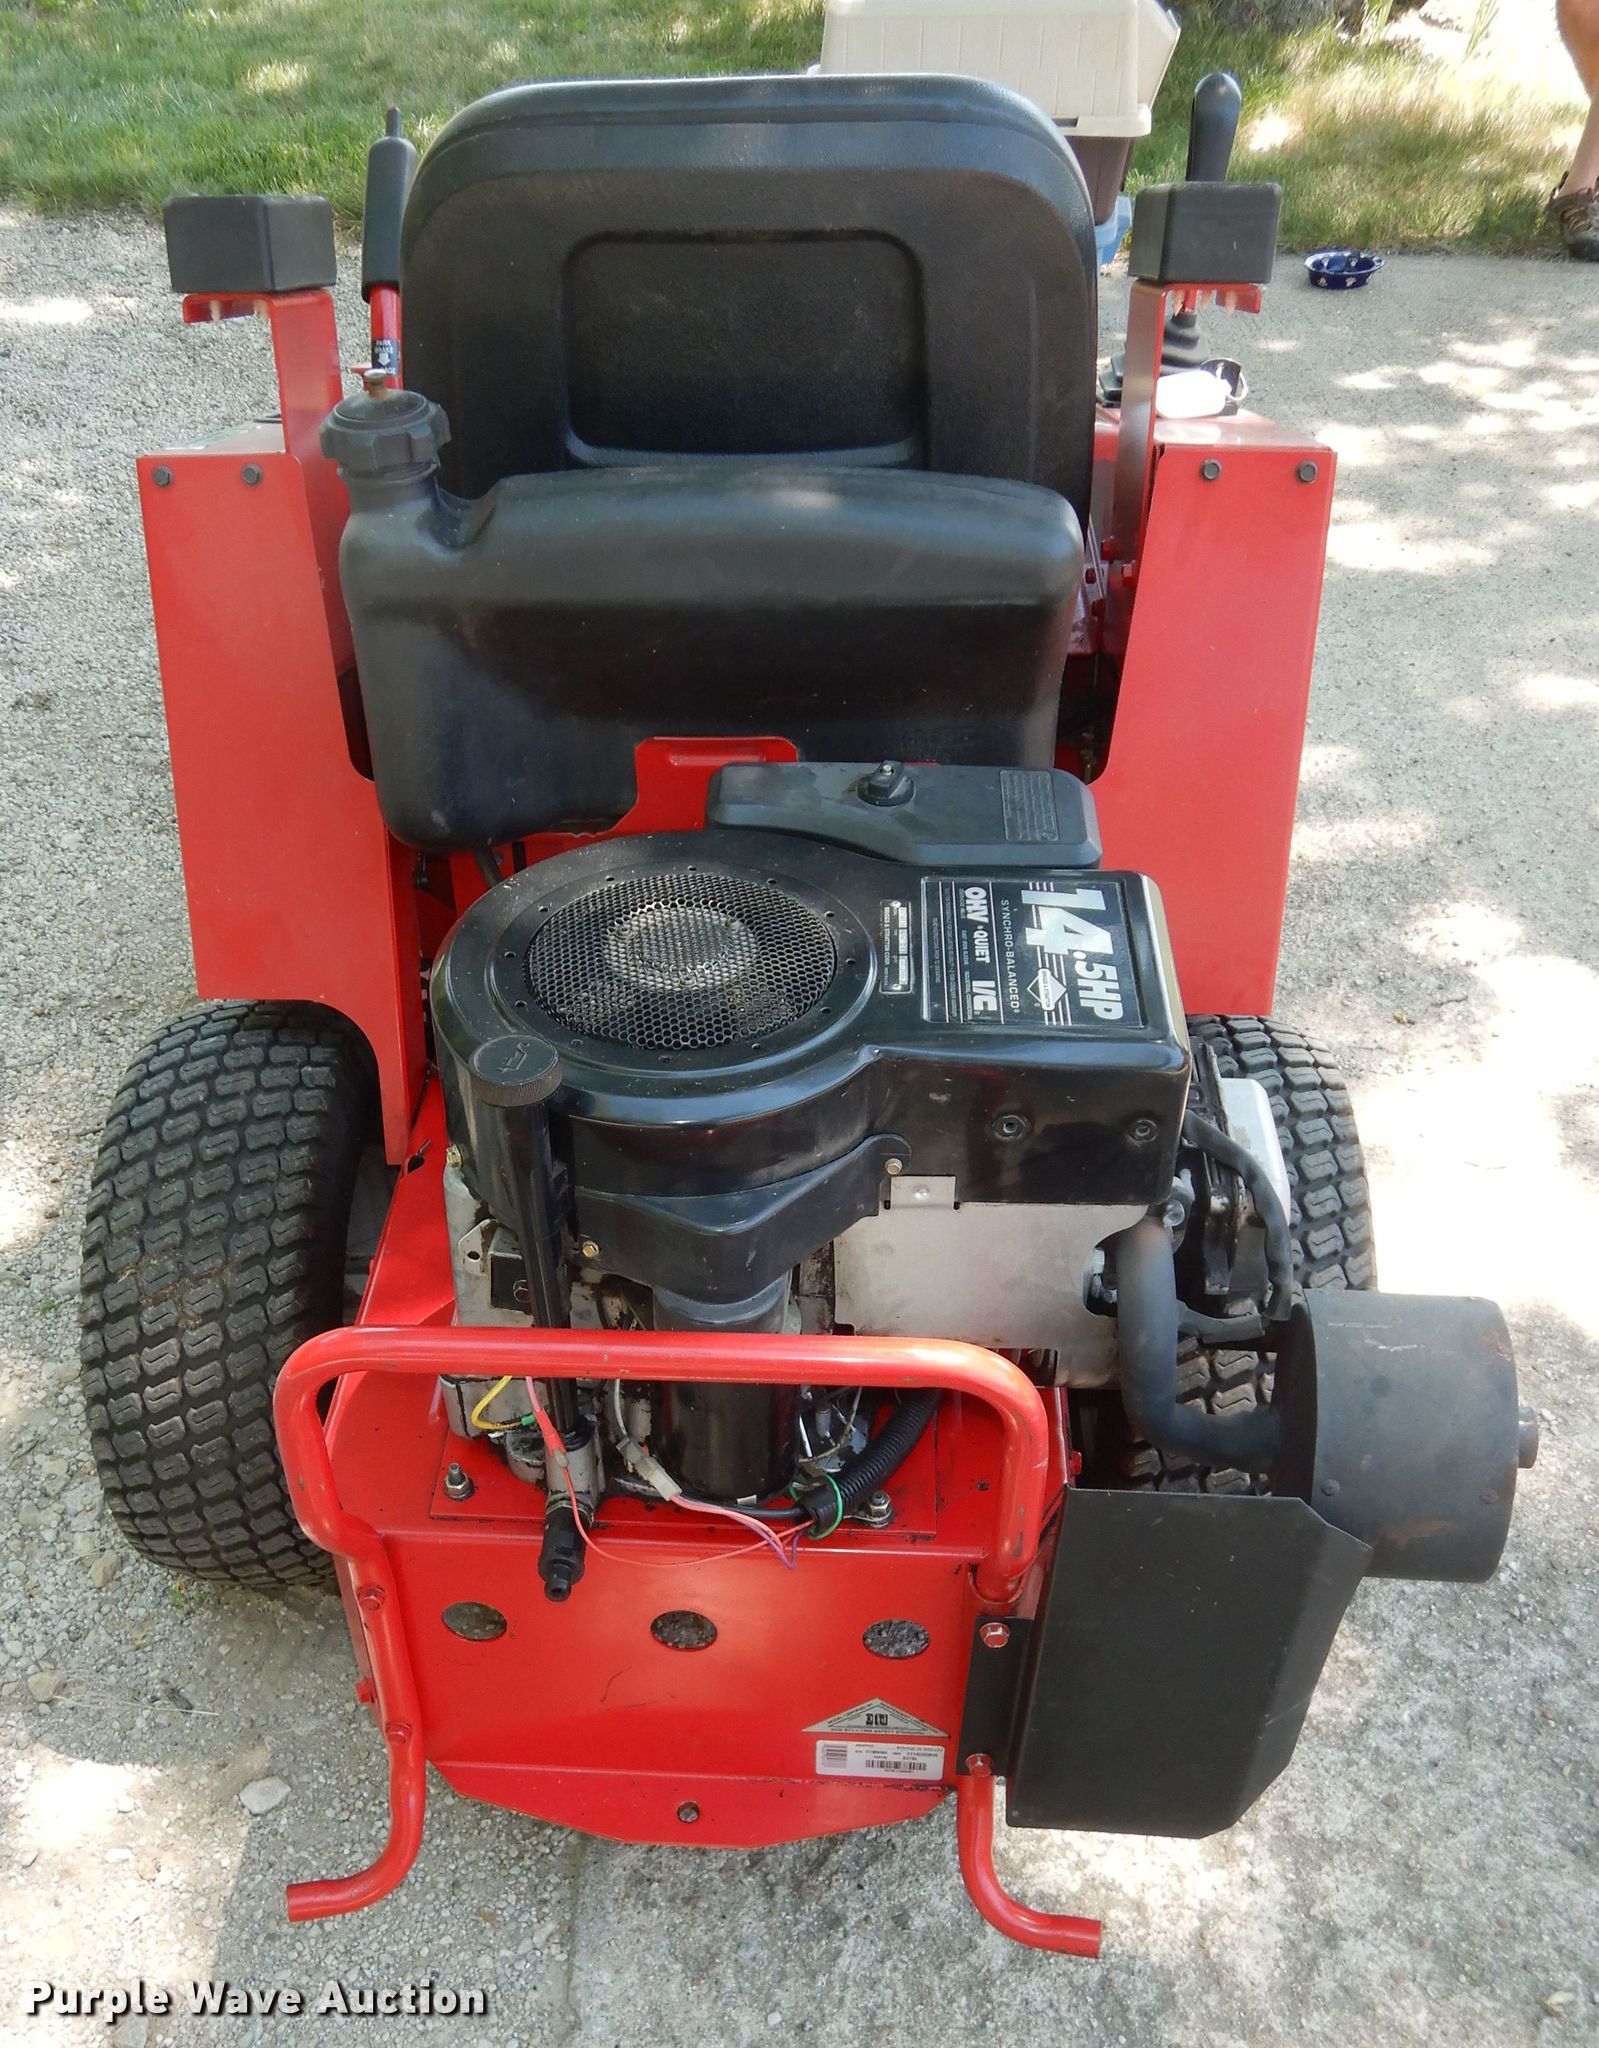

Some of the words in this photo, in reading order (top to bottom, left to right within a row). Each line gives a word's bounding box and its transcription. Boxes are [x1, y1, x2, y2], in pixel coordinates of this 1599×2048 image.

[965, 886, 989, 923] OHV
[973, 930, 990, 963] QUIET
[1021, 888, 1124, 1020] 14.5HP
